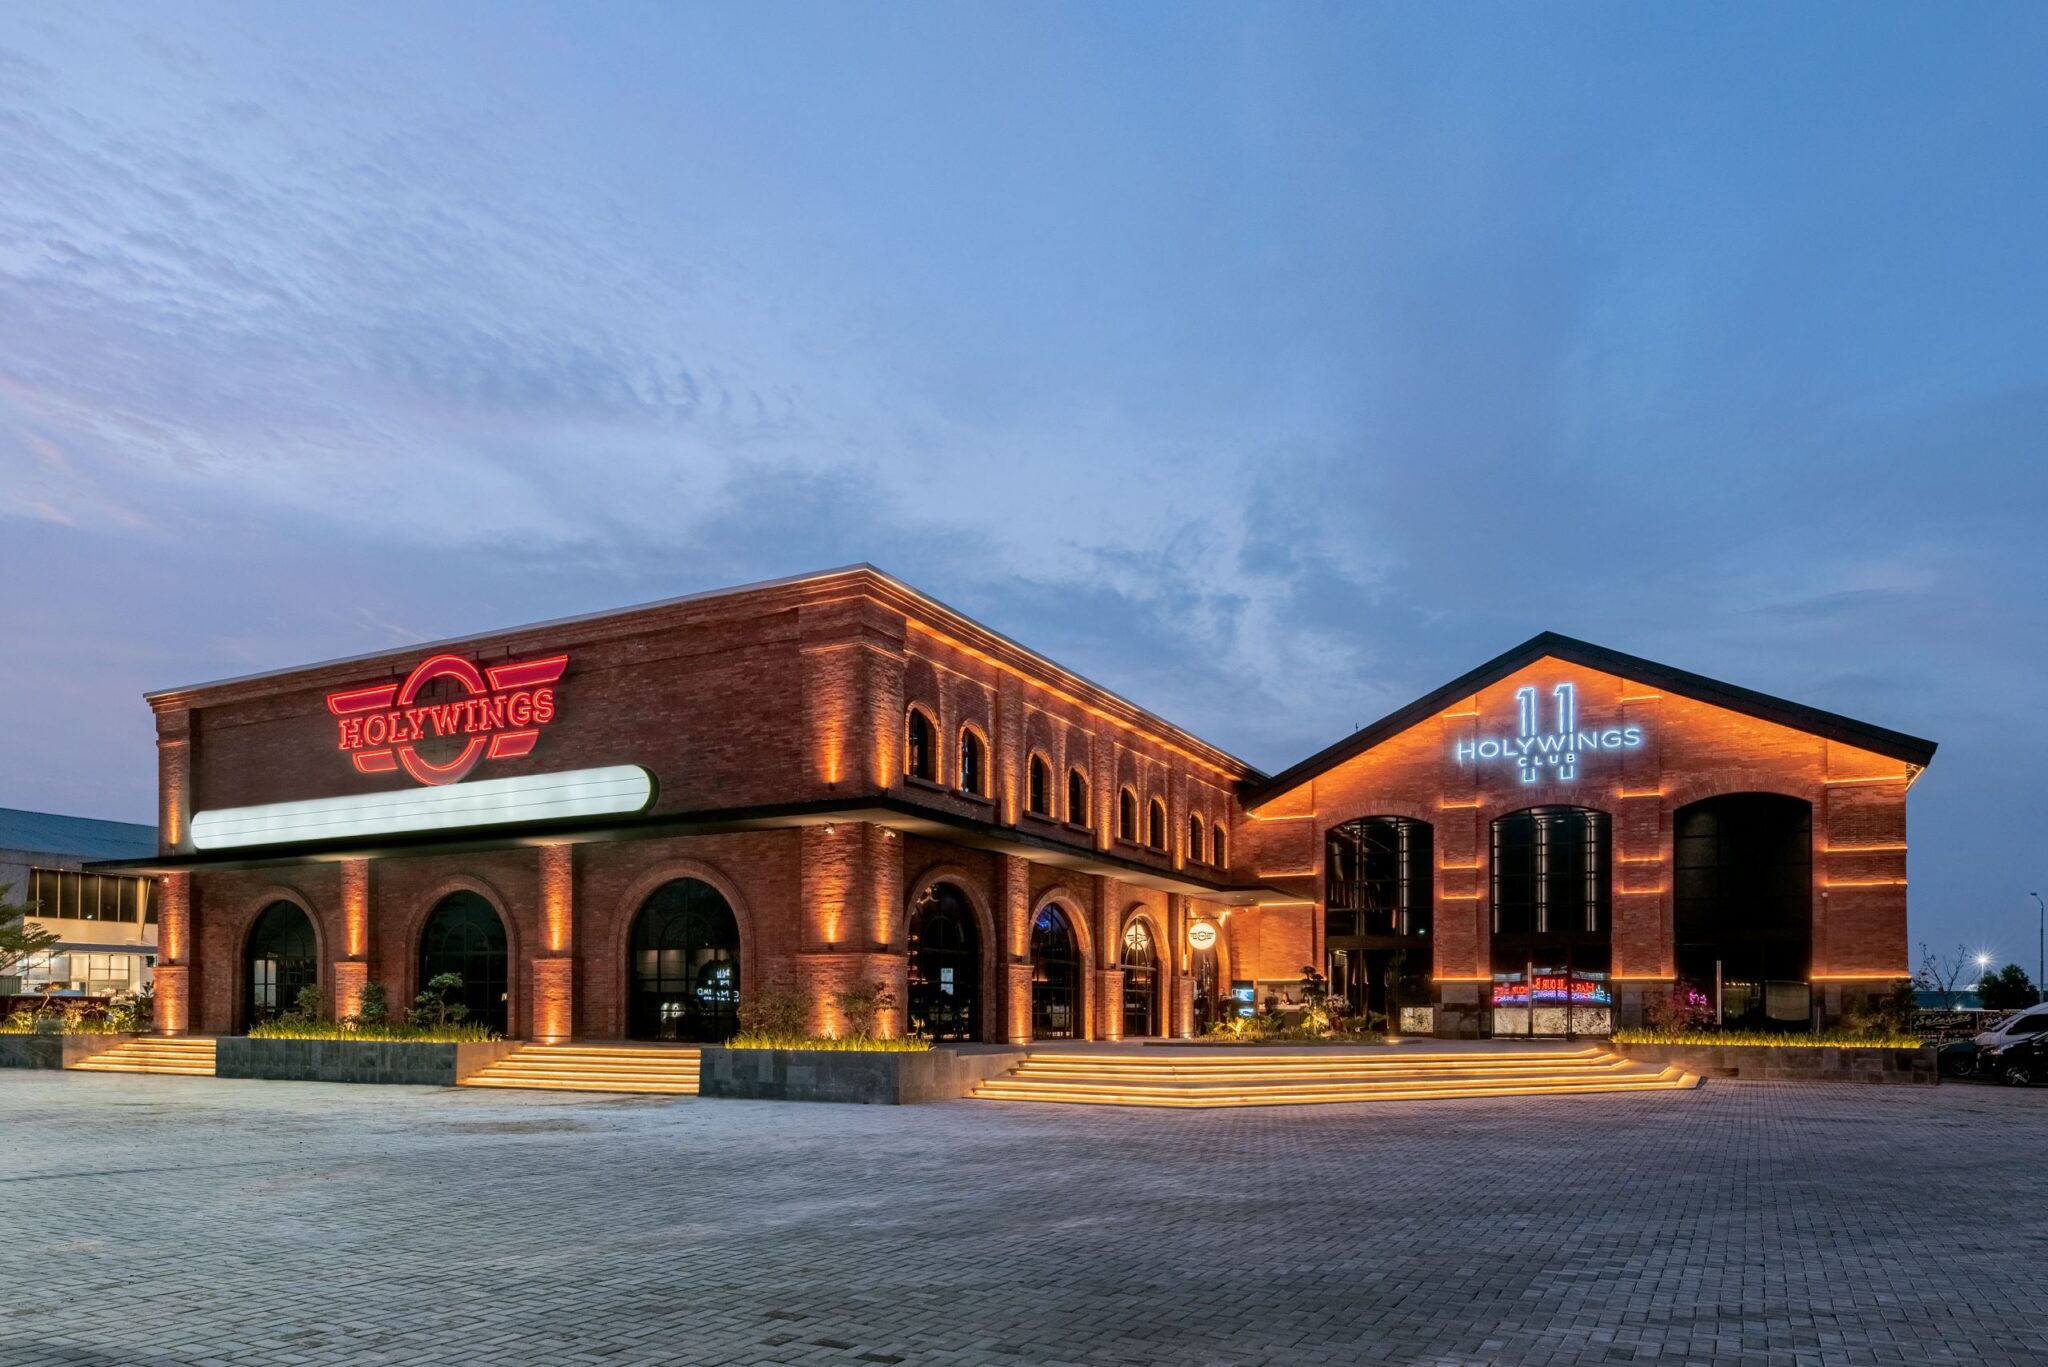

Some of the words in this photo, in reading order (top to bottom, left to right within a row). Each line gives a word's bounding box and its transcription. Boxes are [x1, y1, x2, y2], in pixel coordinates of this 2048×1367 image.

[338, 688, 555, 750] HOLYWINGS
[1457, 729, 1640, 763] HOLYWINGS
[1518, 754, 1575, 767] CLUB
